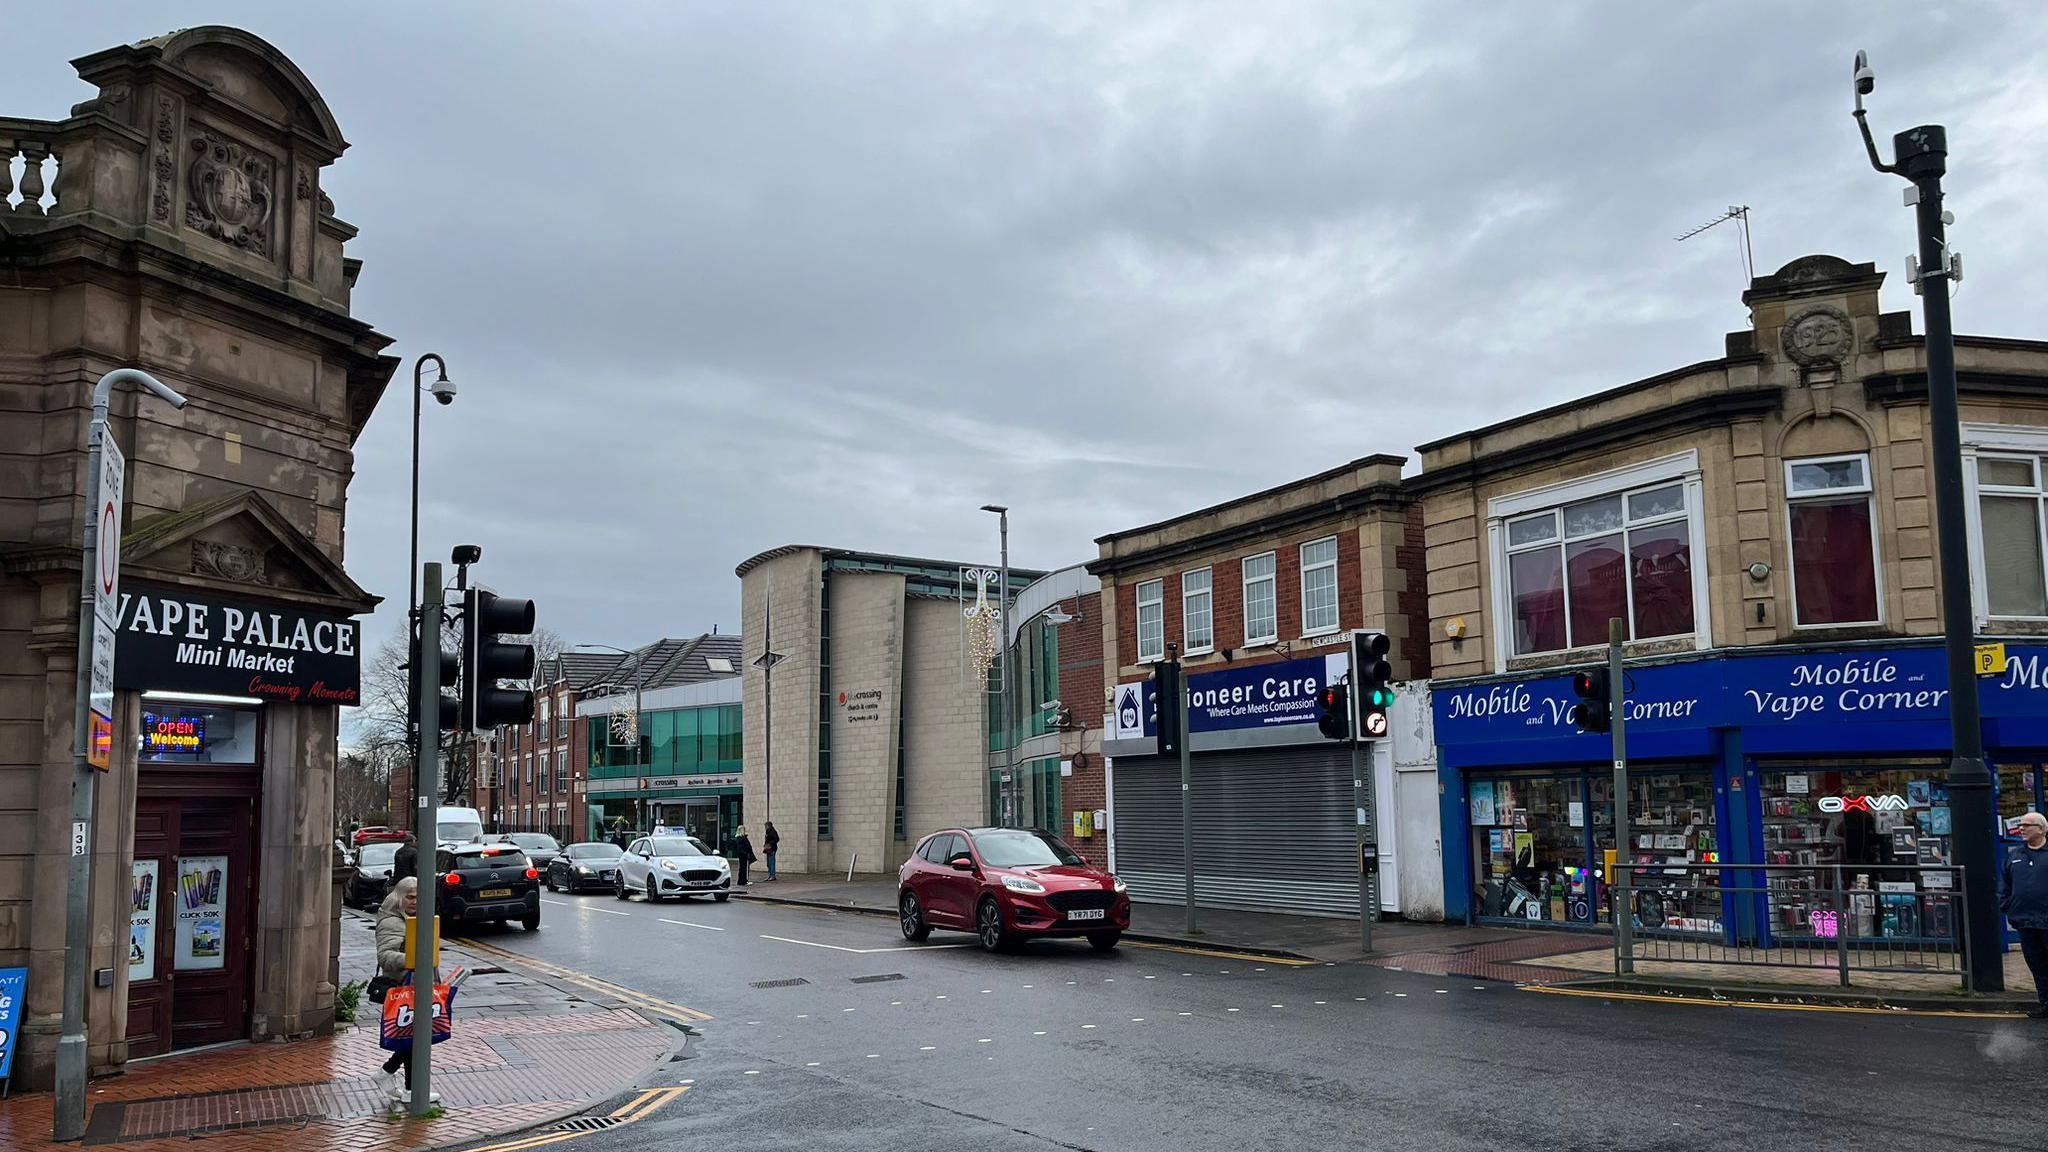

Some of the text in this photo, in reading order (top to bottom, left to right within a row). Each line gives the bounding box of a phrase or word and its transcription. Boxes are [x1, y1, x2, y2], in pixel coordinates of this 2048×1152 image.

[222, 607, 354, 656] PALACE
[176, 643, 295, 674] Mini Market
[1790, 657, 1925, 686] Mobile and
[248, 675, 357, 700] Crowning Moments
[1186, 677, 1317, 708] ioneer Care
[1230, 705, 1247, 716] Care
[1247, 703, 1269, 714] Meets
[1448, 684, 1531, 719] Mobile
[1526, 713, 1545, 725] and
[1622, 699, 1697, 720] Corner
[1744, 689, 1949, 720] Vape Corner
[150, 732, 200, 745] Welcome
[158, 722, 193, 734] OPEN
[1818, 794, 1909, 812] OXVA
[179, 910, 220, 919] CLICK 50K
[390, 990, 410, 1000] LOVE
